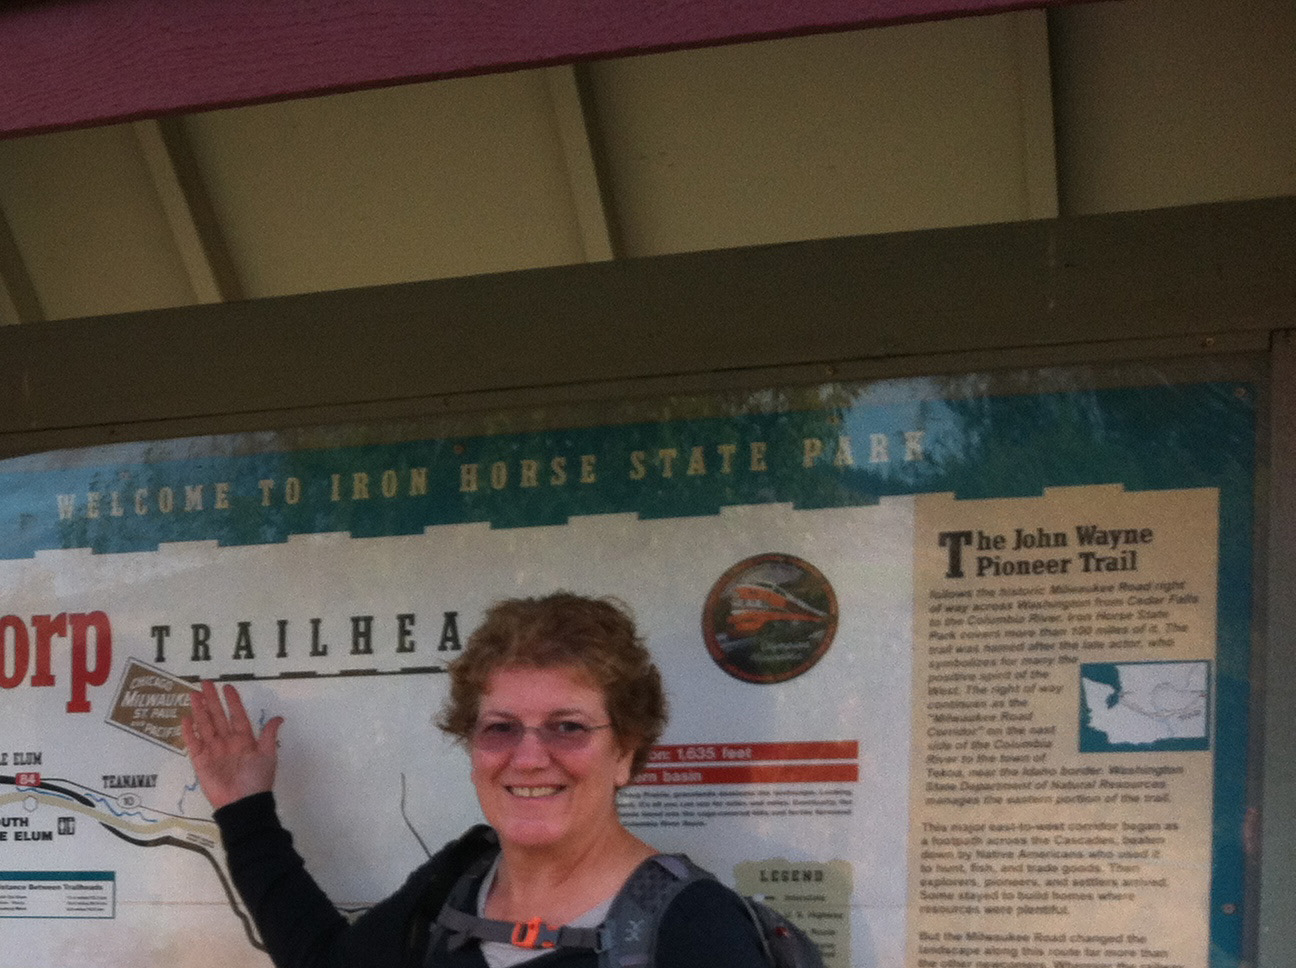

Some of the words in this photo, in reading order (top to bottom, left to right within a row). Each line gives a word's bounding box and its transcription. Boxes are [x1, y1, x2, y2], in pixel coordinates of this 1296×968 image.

[56, 482, 231, 520] WELCOME
[258, 477, 301, 506] TO
[331, 467, 429, 501] IRON
[460, 454, 597, 493] HORSE
[629, 441, 768, 480] STATE
[801, 430, 926, 469] PARK
[938, 530, 1006, 578] The
[1014, 528, 1068, 550] John
[1076, 525, 1153, 549] Wayne
[976, 555, 1072, 577] Pioneer
[1079, 550, 1137, 572] Trail
[151, 611, 462, 663] TRAILHEA
[121, 691, 192, 707] MILWAUKE
[150, 708, 177, 718] PAUL
[13, 752, 42, 765] ELUM
[722, 747, 752, 759] feet
[19, 774, 36, 785] 84
[102, 774, 158, 788] TEANAWAY
[124, 797, 134, 805] 10
[14, 831, 53, 841] ELUM
[760, 869, 823, 882] LEGEND
